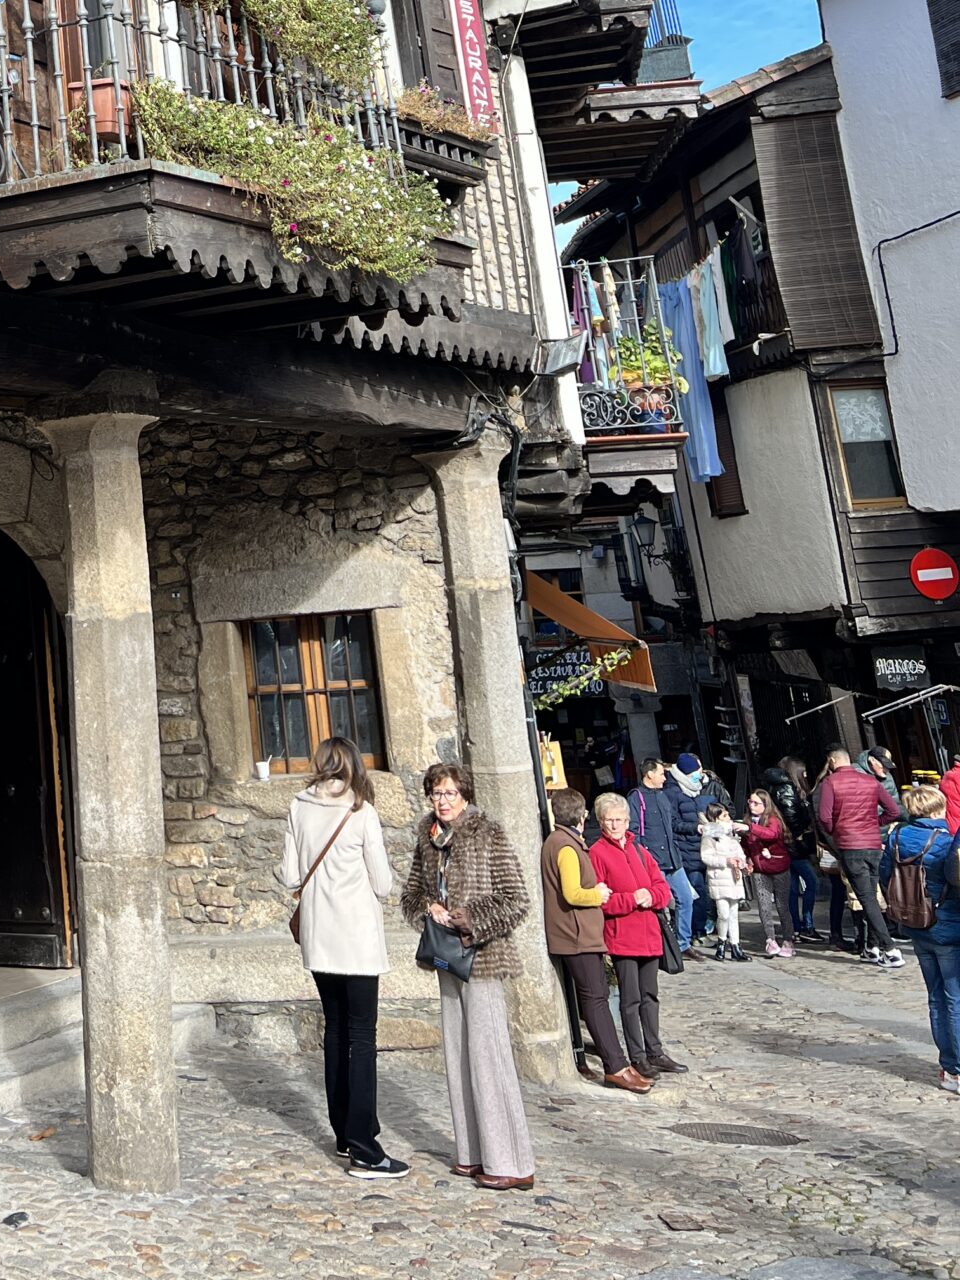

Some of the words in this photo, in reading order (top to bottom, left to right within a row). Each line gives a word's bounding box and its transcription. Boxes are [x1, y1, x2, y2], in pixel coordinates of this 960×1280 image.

[536, 651, 592, 664] CERIA
[876, 658, 927, 675] MARCOS
[529, 680, 544, 694] EL
